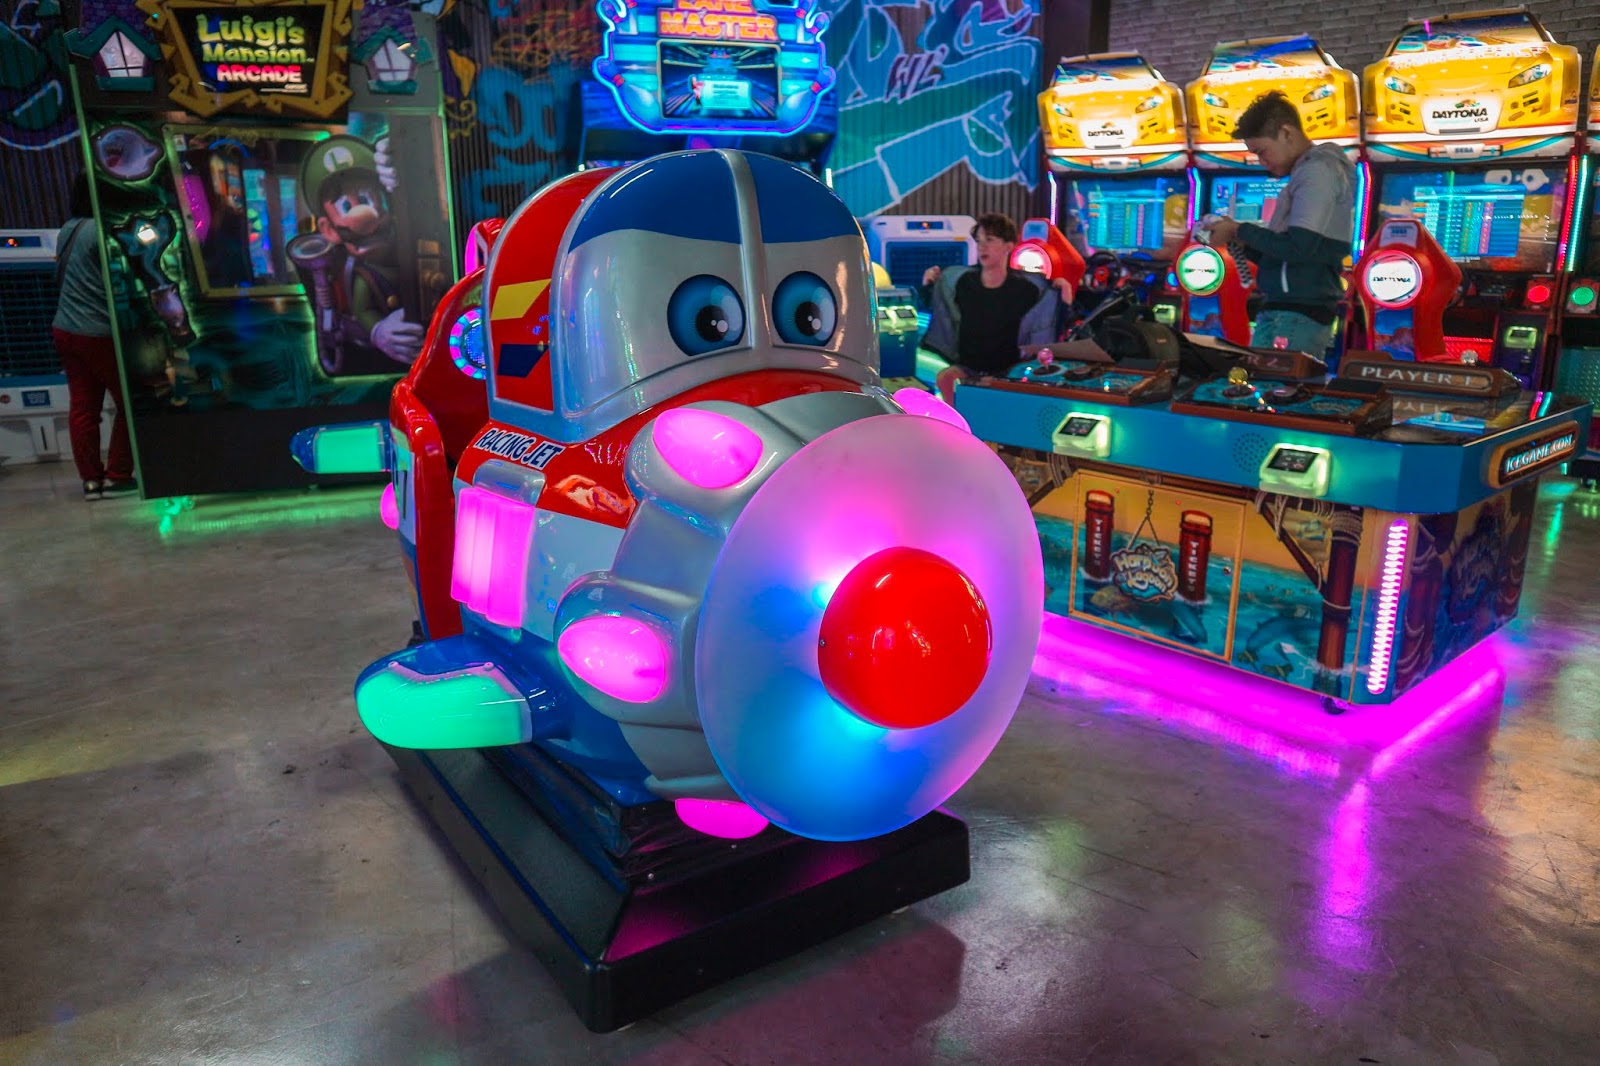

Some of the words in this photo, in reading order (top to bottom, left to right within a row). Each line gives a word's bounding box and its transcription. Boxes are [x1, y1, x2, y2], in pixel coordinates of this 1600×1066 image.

[196, 14, 305, 47] Luigi's
[659, 10, 780, 41] MASTER
[202, 42, 307, 62] Mansion
[217, 64, 302, 82] ARCADE
[1432, 108, 1488, 119] DAYTONA
[1361, 366, 1452, 385] PLAYER
[473, 428, 537, 461] RACING
[521, 441, 567, 470] JET
[1505, 433, 1574, 473] ICEGAME.COM
